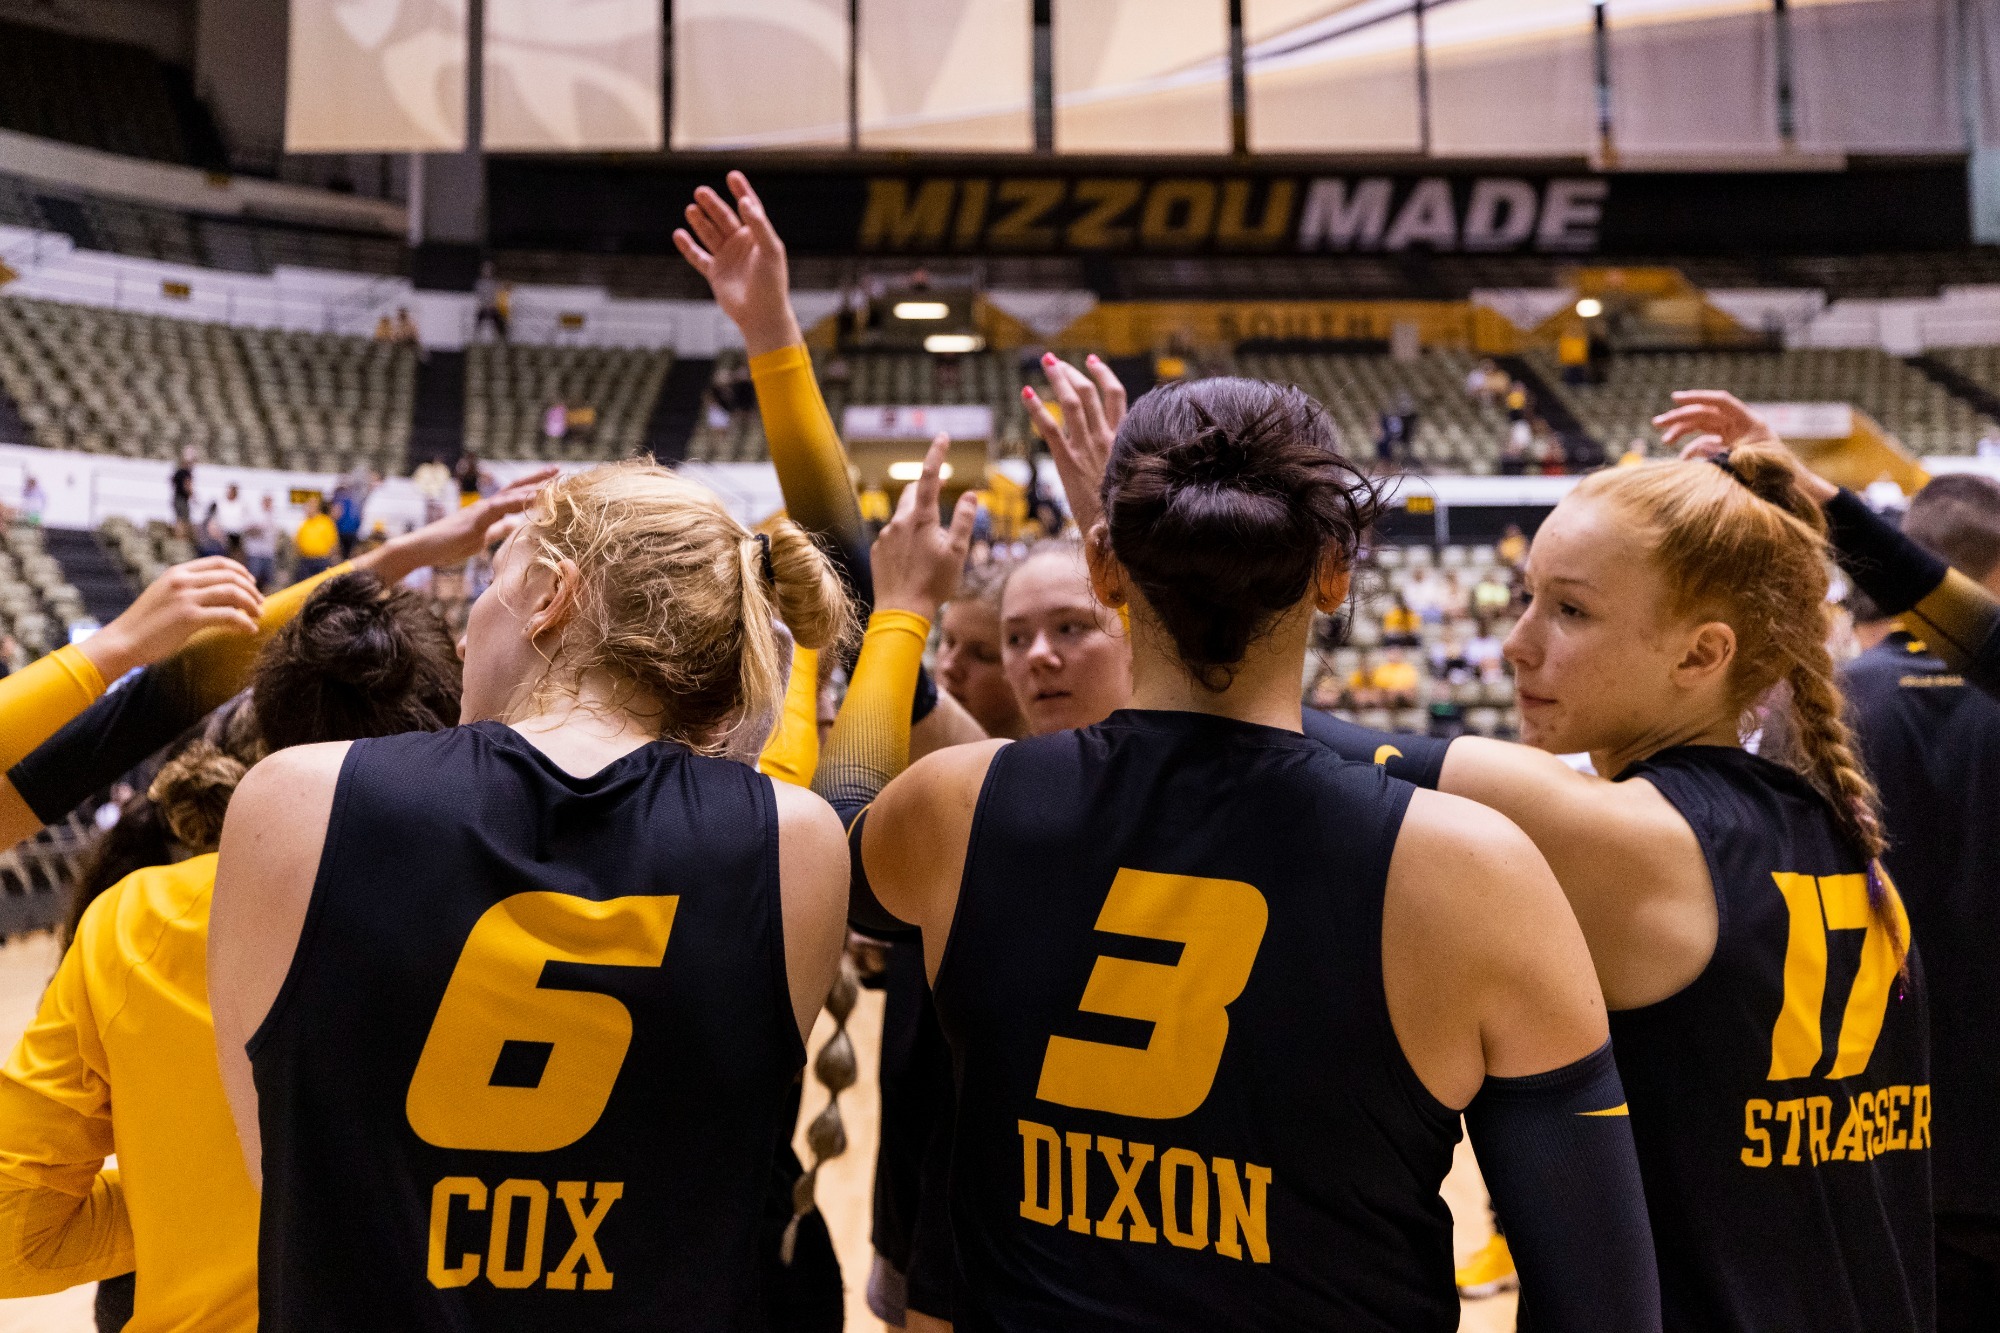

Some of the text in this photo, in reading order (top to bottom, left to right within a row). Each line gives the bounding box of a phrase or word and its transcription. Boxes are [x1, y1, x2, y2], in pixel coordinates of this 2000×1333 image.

[405, 890, 680, 1153] 6
[1036, 867, 1269, 1119] 3
[1766, 871, 1911, 1081] 17
[1017, 1118, 1272, 1264] DIXON
[1740, 1084, 1932, 1168] STRASSER
[426, 1176, 624, 1290] COX
